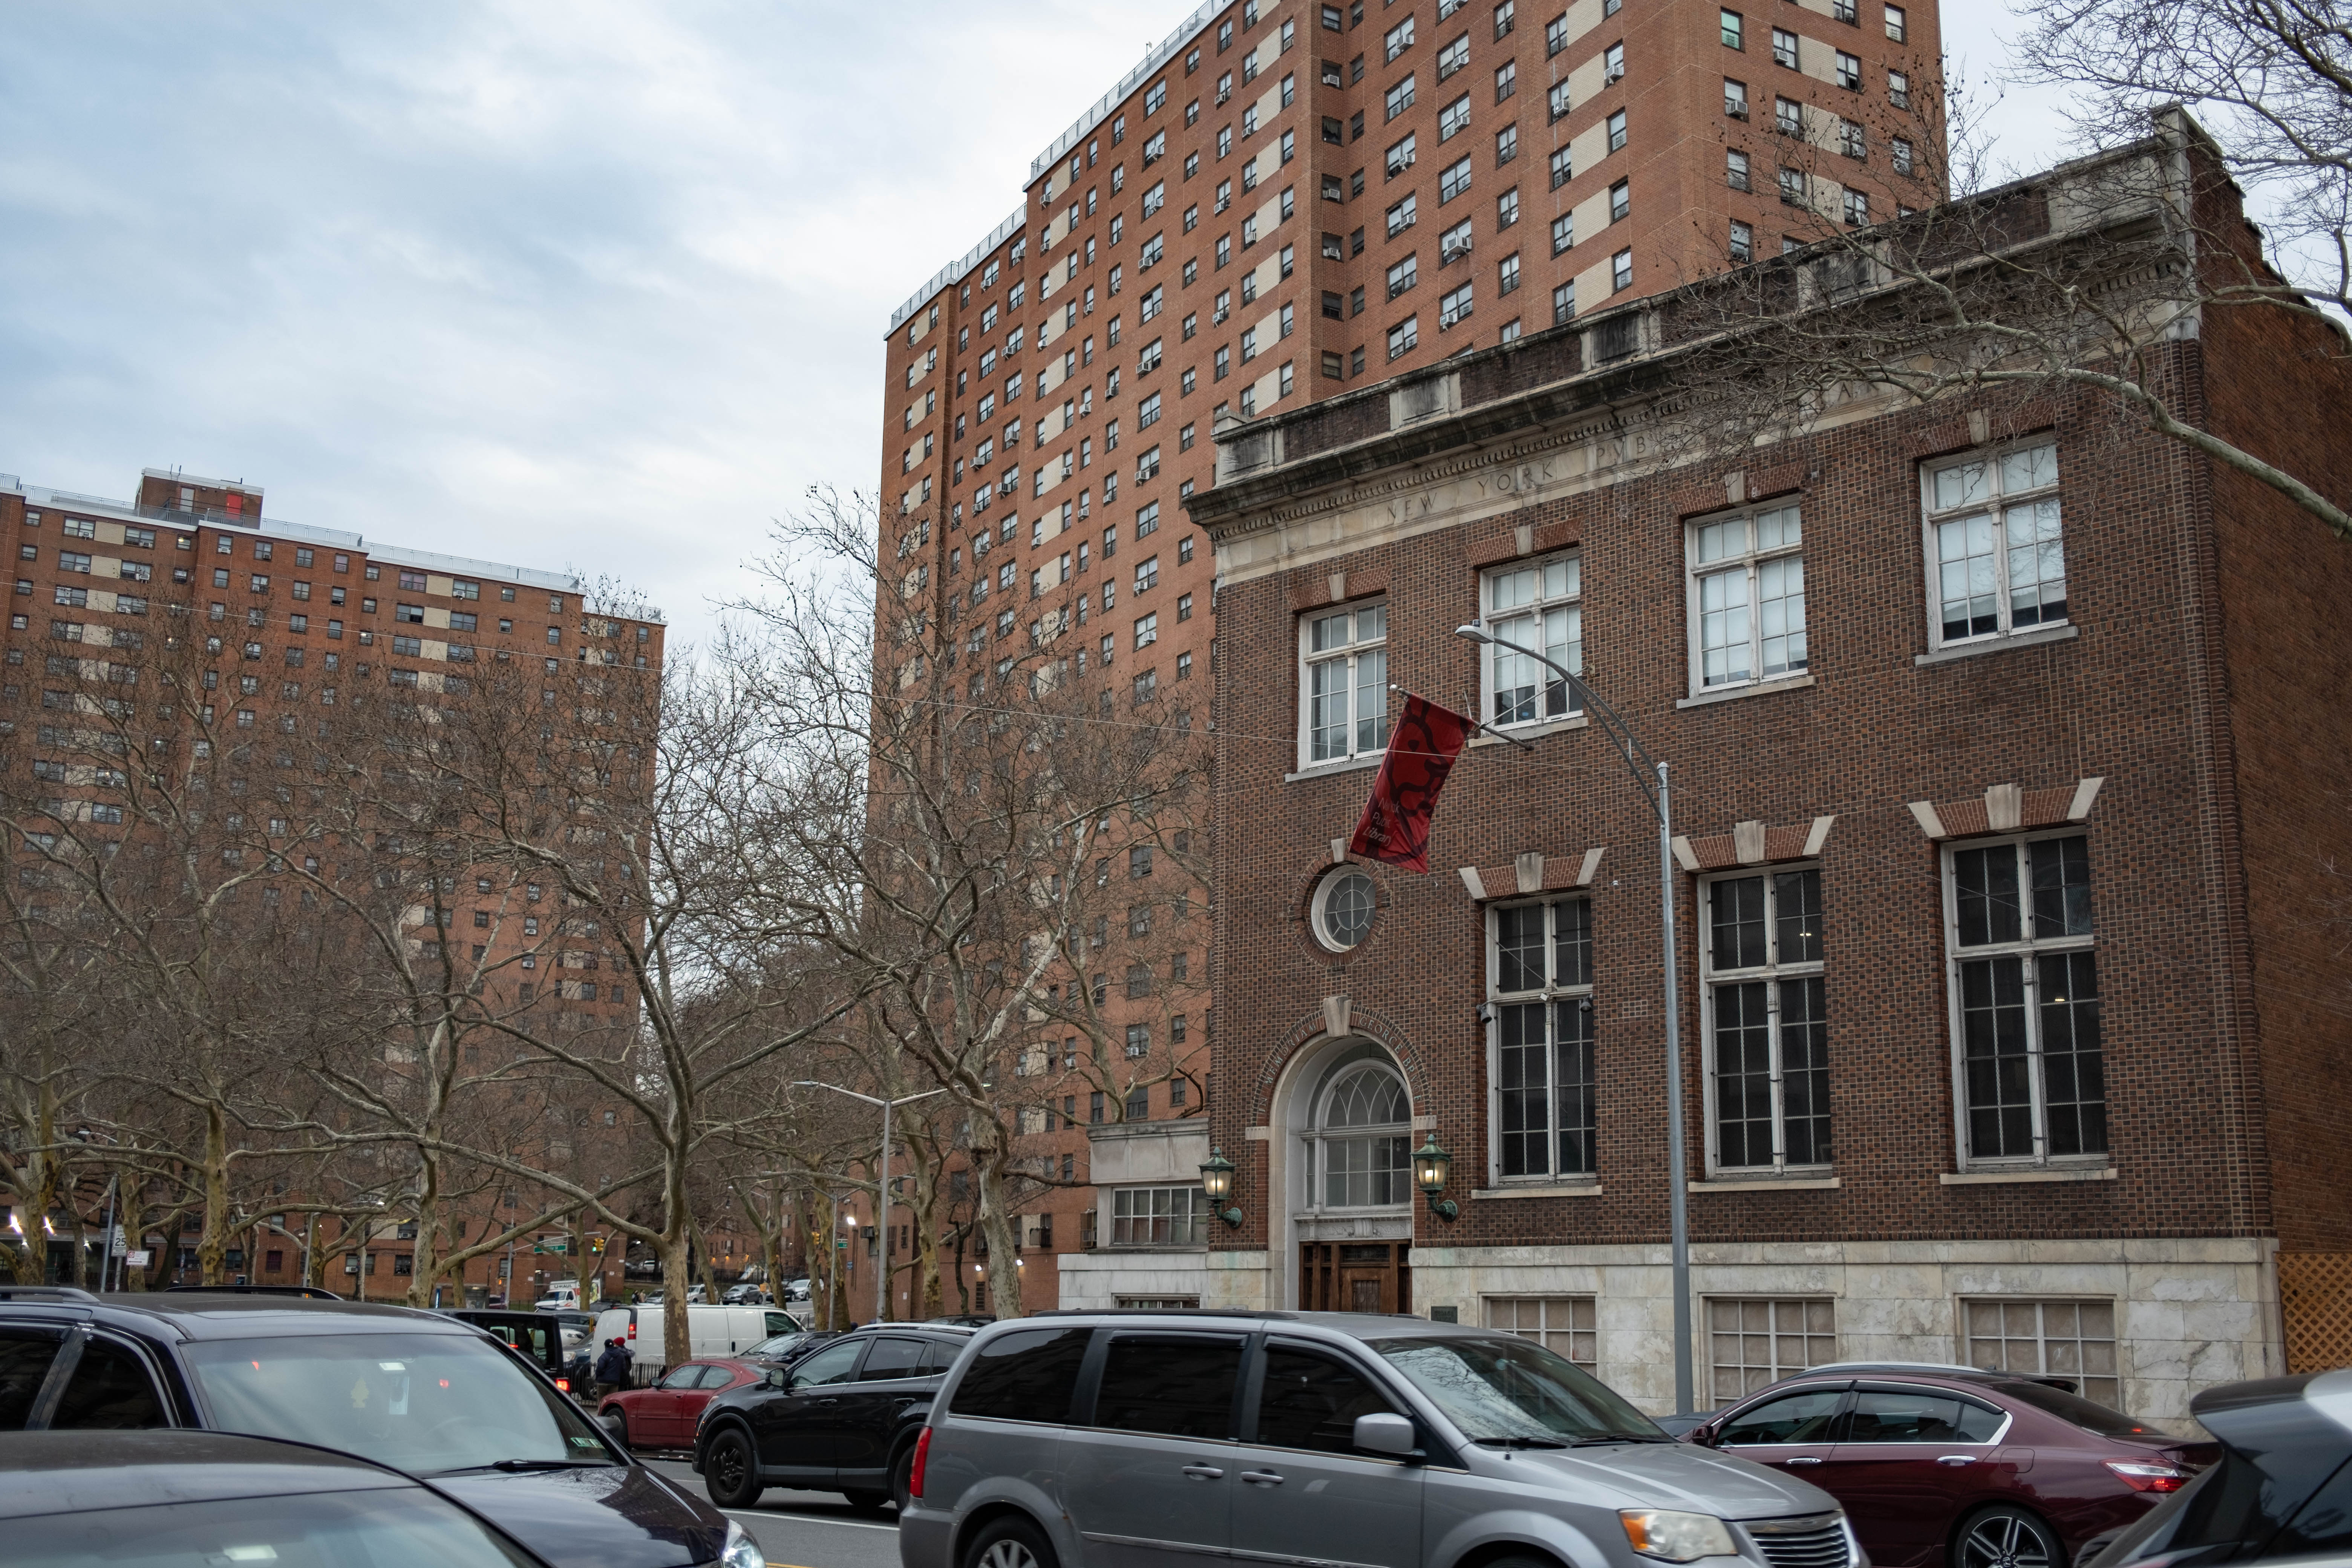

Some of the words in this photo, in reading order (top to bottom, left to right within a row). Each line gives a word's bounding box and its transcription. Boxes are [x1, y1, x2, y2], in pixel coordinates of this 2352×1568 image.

[1387, 490, 1437, 522] NEW
[1478, 461, 1553, 496] YORK
[1362, 826, 1391, 846] Library
[1258, 1097, 1268, 1113] IN
[1265, 1023, 1317, 1085] MEMORIAM
[1359, 1016, 1403, 1054] GEORGE
[115, 1237, 126, 1246] 25
